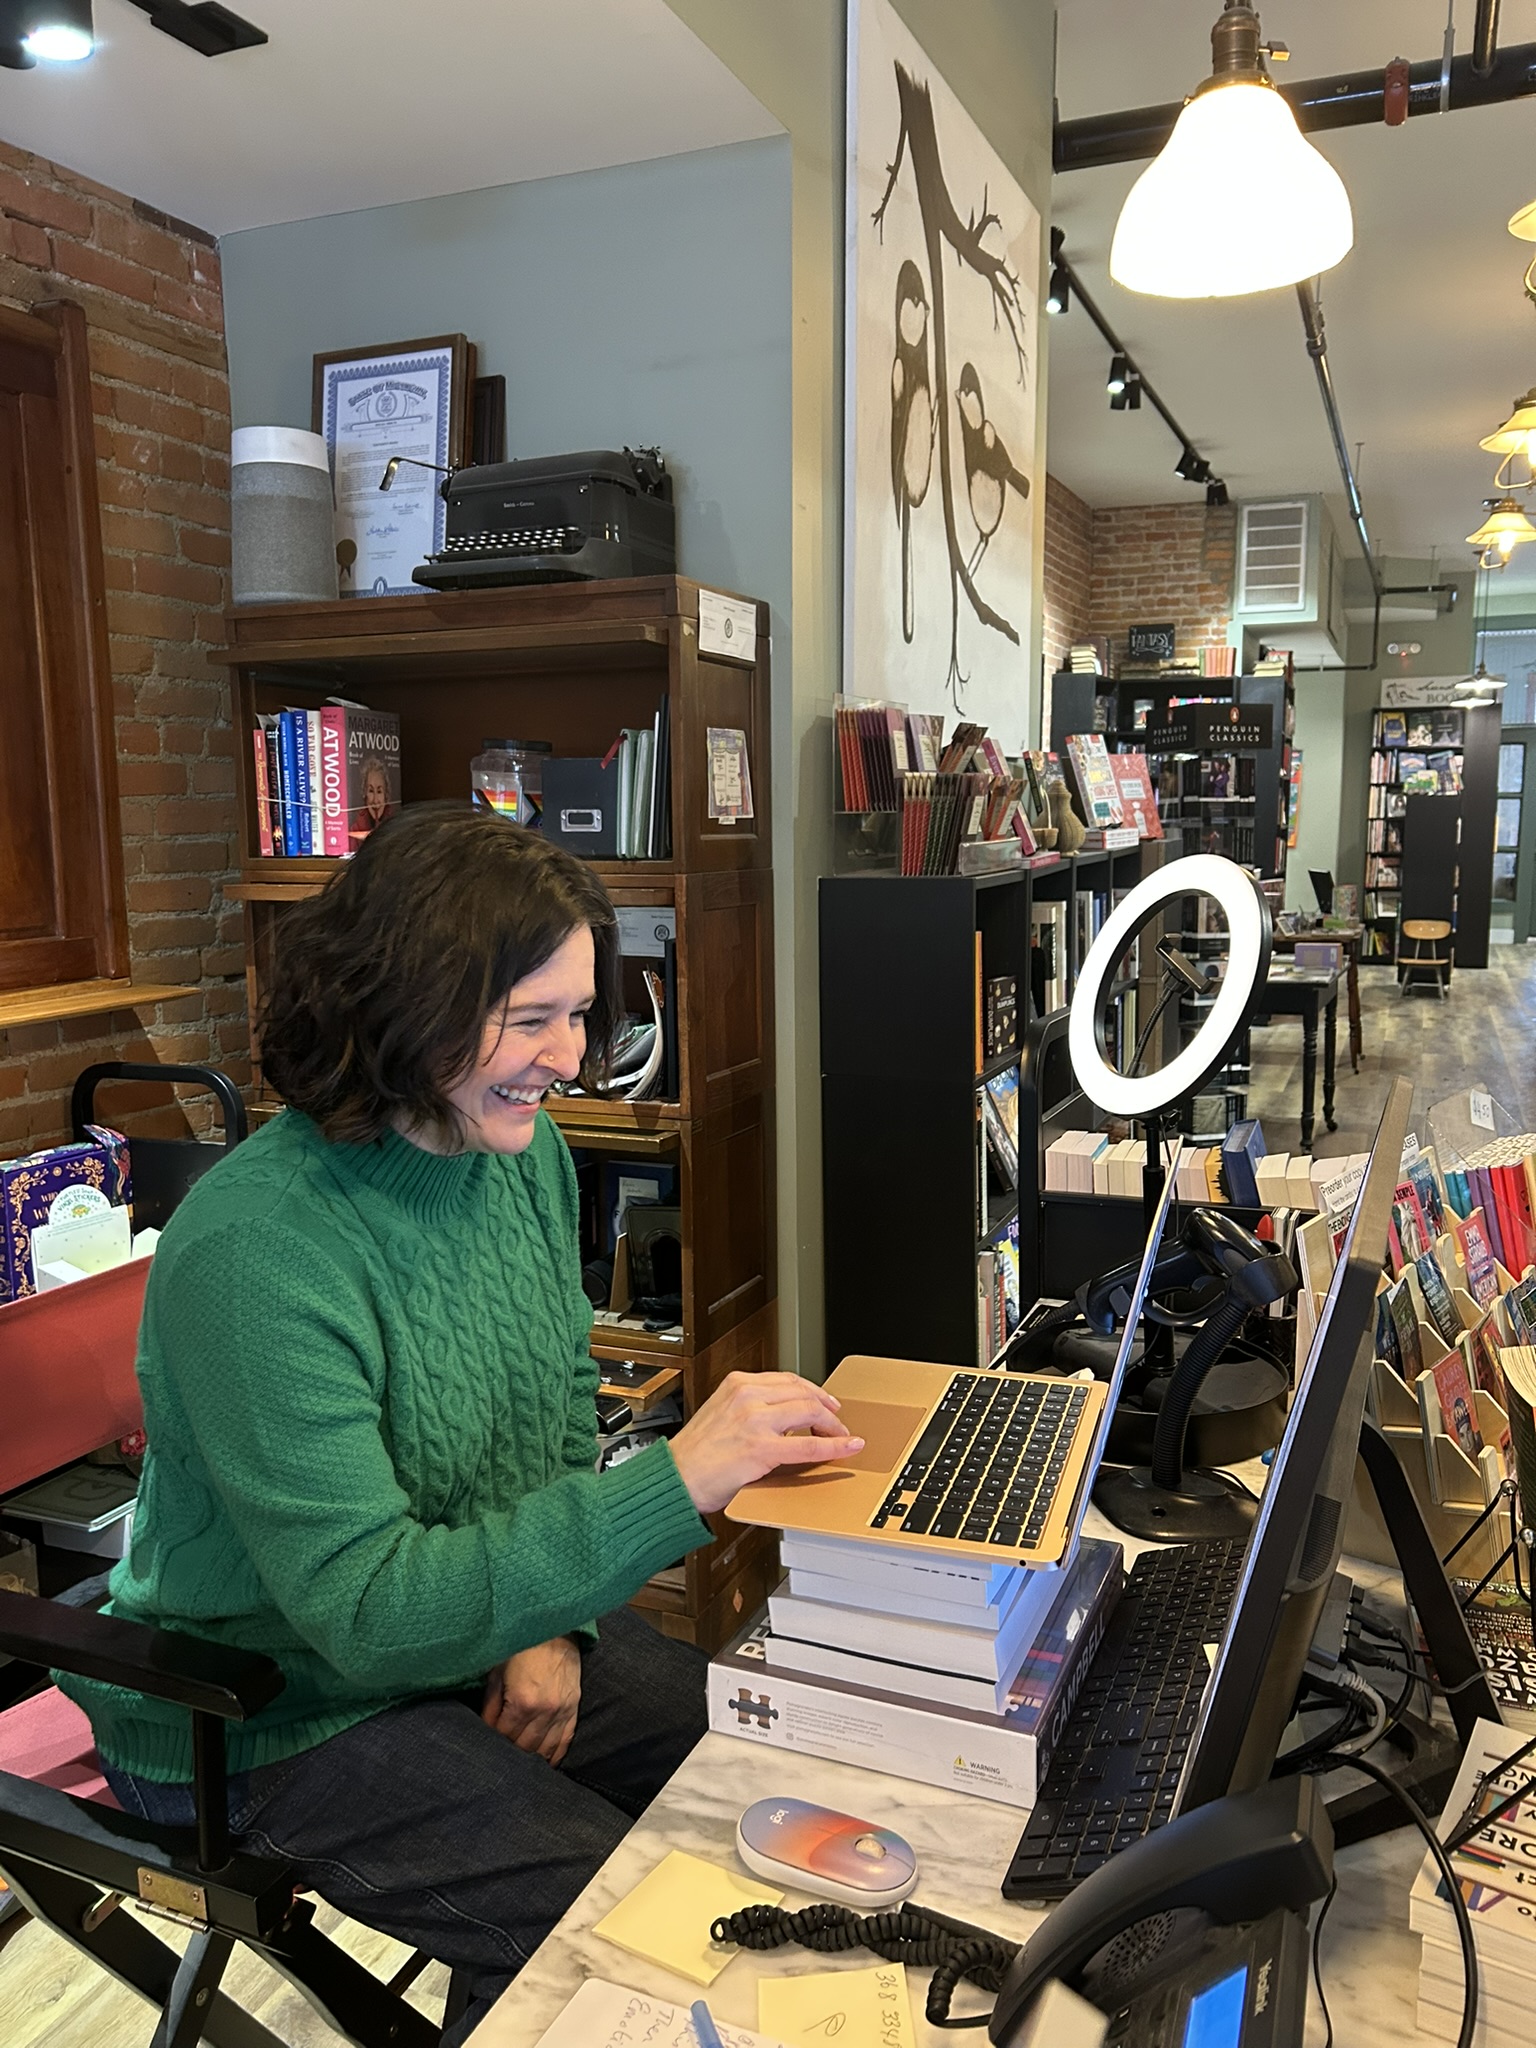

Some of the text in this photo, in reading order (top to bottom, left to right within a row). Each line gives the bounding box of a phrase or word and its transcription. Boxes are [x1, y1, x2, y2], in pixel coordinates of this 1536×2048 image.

[1131, 632, 1170, 648] FANTASY
[296, 716, 302, 726] IS
[308, 720, 315, 733] SO
[348, 716, 400, 735] MARGARET
[1154, 726, 1188, 736] PENGUIN
[1154, 734, 1188, 745] CLASSICS
[349, 731, 400, 752] ATWOOD
[309, 754, 317, 777] GONE
[322, 726, 341, 818] ATWOOD
[284, 770, 292, 819] HOMESCHOOLED
[298, 770, 306, 803] ALIVE?
[1320, 1178, 1344, 1198] Preorder
[1396, 1184, 1416, 1200] SEMPLE
[1052, 1612, 1106, 1748] CAMPBELL
[740, 1727, 757, 1736] ACTUAL
[970, 1762, 1000, 1775] WARNING
[770, 1809, 789, 1825] logi
[1254, 1957, 1273, 2017] Yealink
